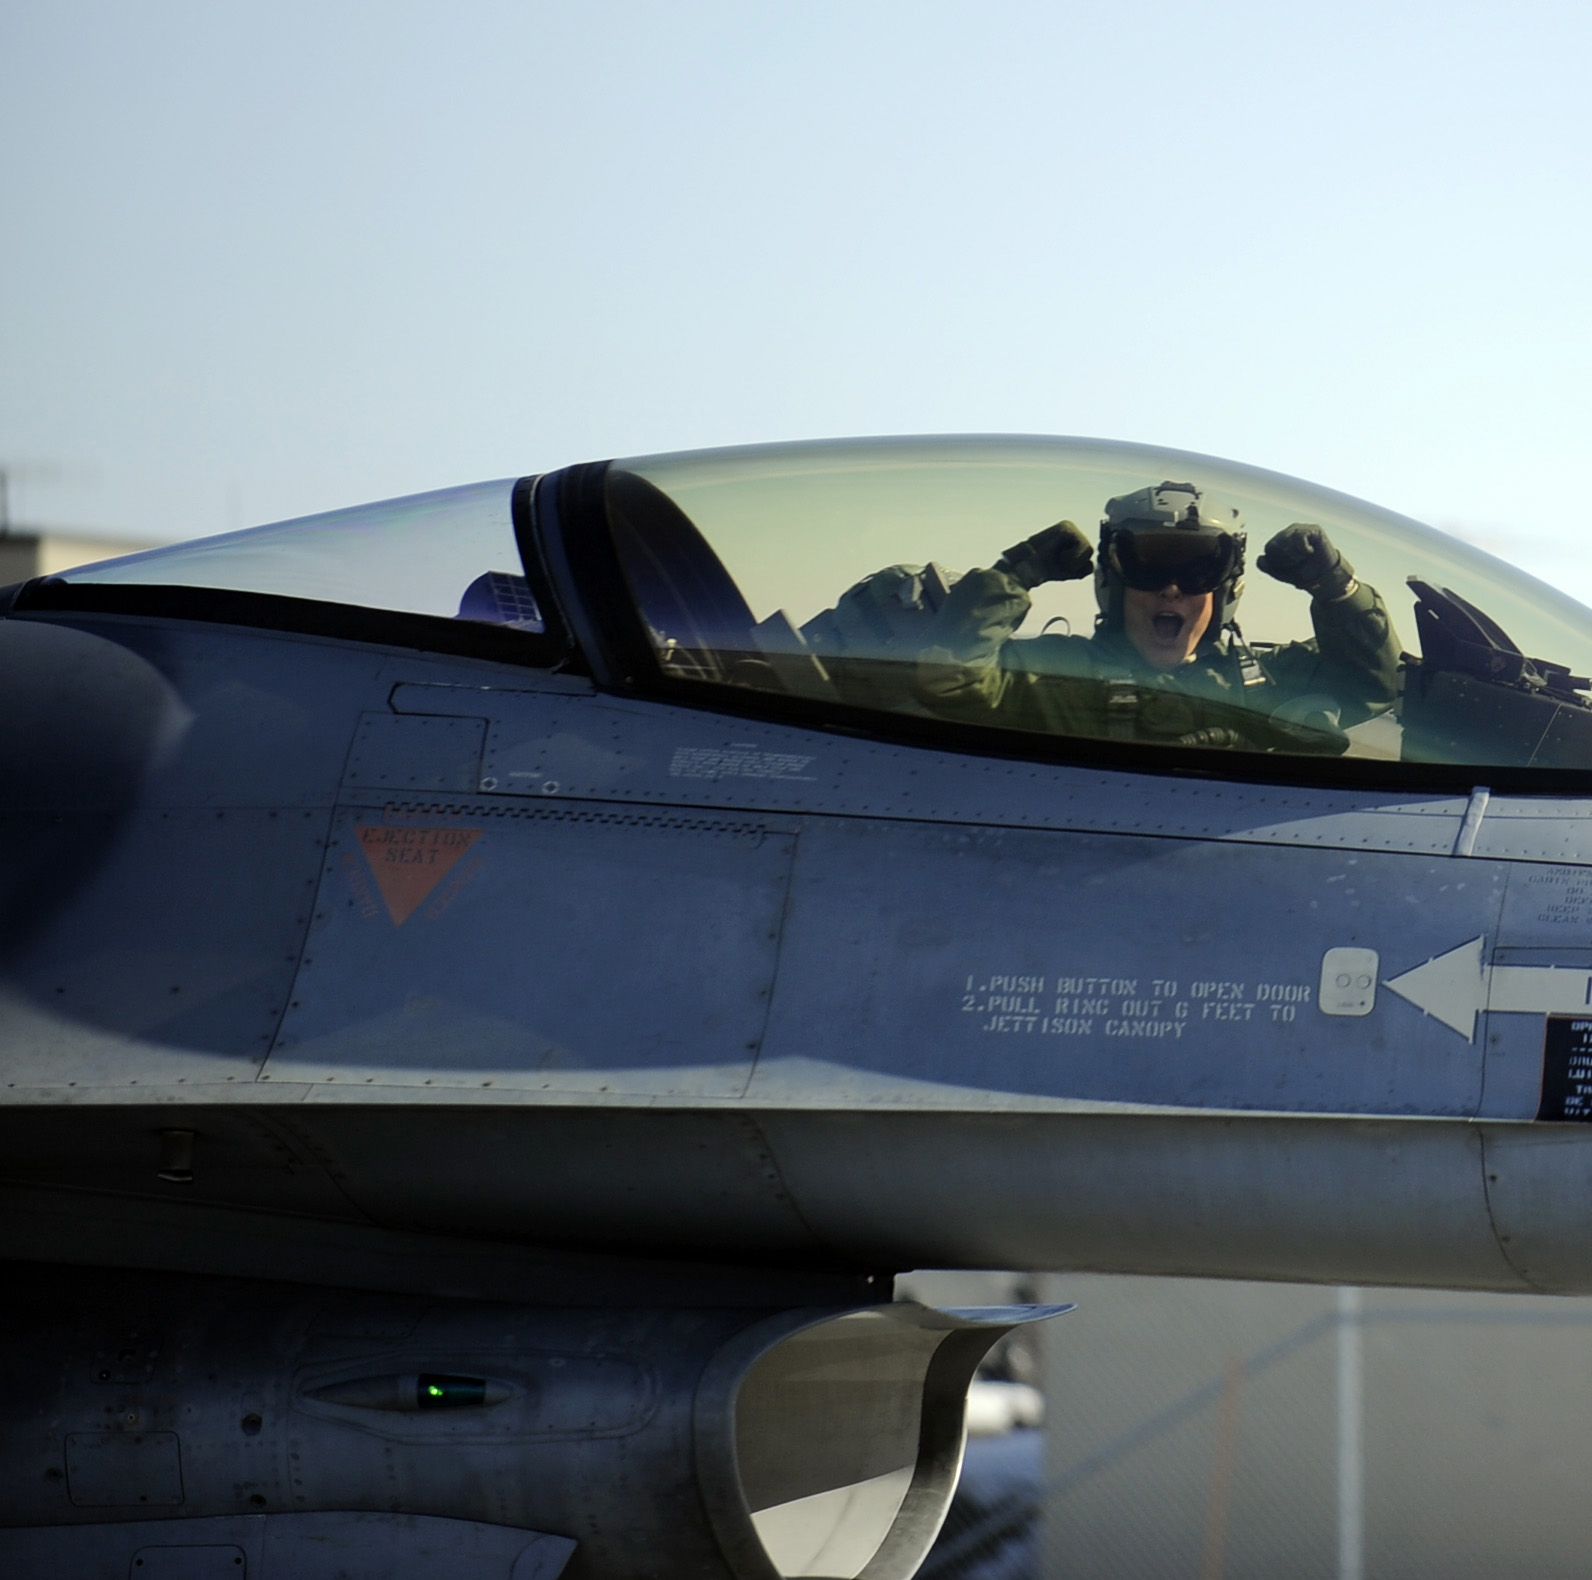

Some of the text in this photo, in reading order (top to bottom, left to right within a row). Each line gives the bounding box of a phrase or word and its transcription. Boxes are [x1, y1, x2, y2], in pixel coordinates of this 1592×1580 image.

[362, 828, 471, 847] EJECTION
[385, 848, 439, 865] SEAT
[1057, 978, 1138, 997] BUTTON
[1152, 979, 1177, 998] TO
[1191, 981, 1244, 1000] OPEN
[1256, 983, 1311, 1002] DOOR
[1055, 998, 1109, 1016] RING
[1122, 1000, 1163, 1018] OUT
[1201, 1003, 1253, 1021] FEET
[1270, 1004, 1296, 1022] TO
[984, 1016, 1187, 1039] JETTISON CANOPY
